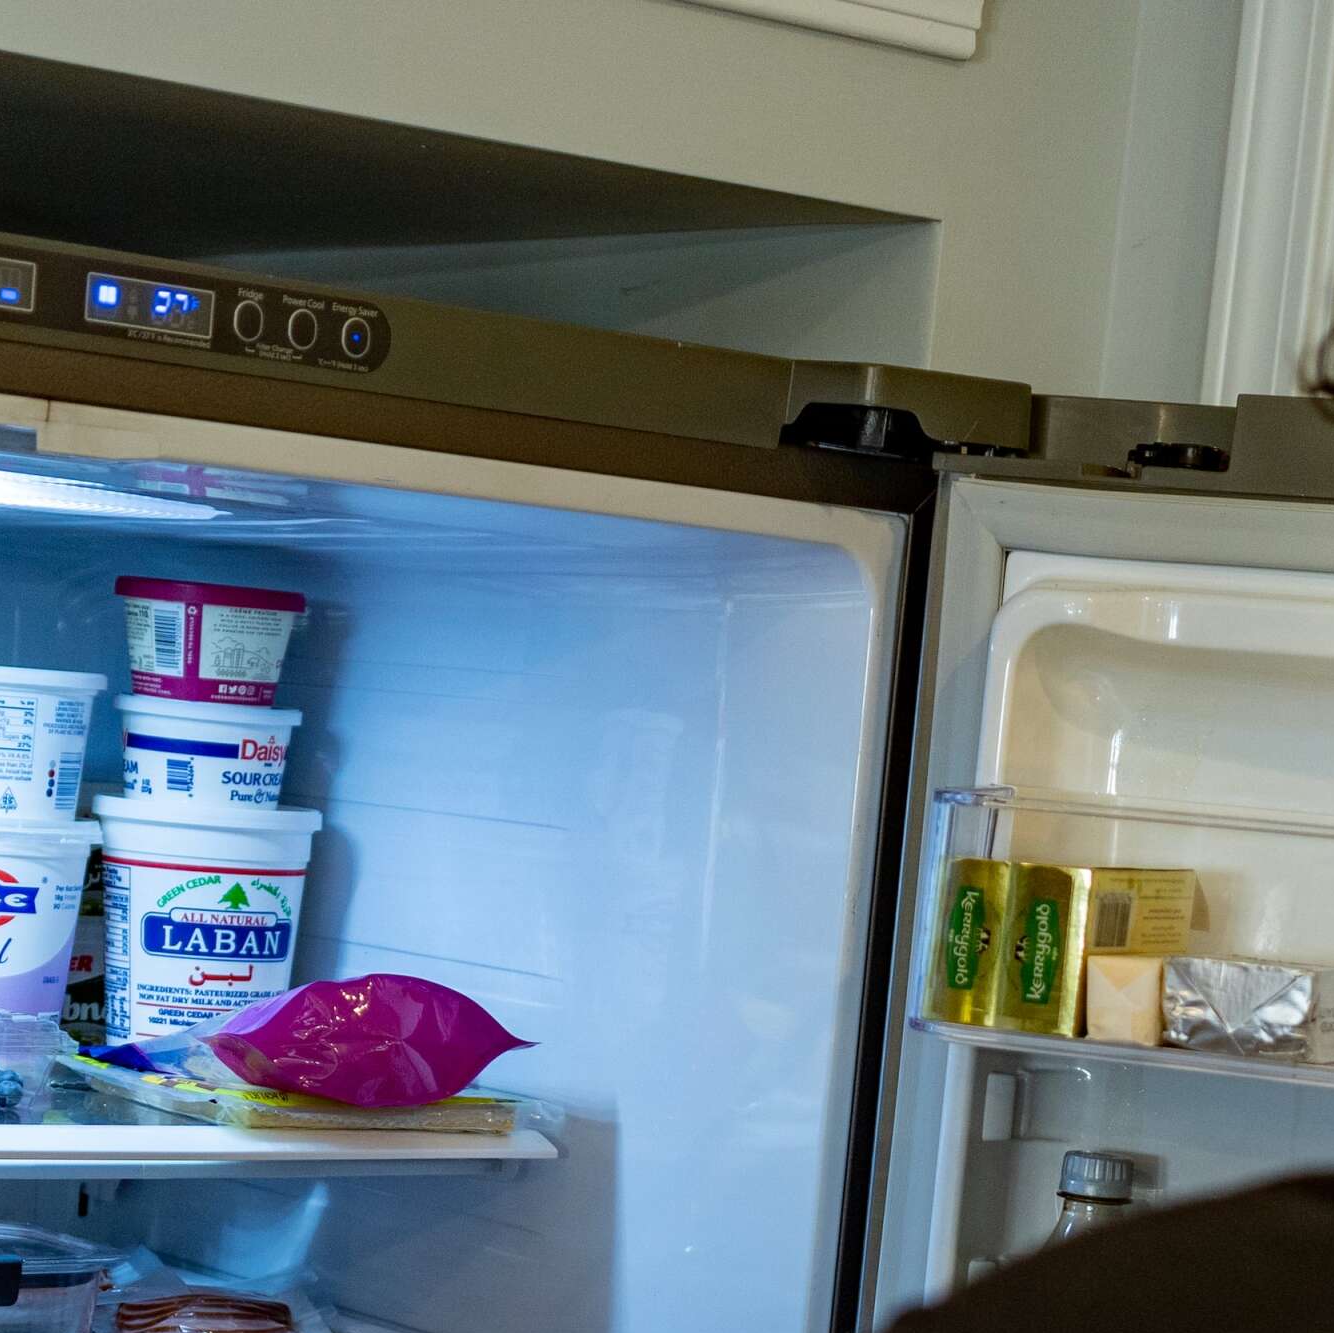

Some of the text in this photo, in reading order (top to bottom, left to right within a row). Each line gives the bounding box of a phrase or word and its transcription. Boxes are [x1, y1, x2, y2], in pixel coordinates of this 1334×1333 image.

[238, 287, 264, 300] Fridge
[282, 294, 325, 310] Power Cool
[332, 302, 379, 317] Energy Saver
[221, 770, 261, 786] SOUR
[230, 790, 253, 801] Pure
[156, 875, 222, 908] GREEN CEDAR
[181, 912, 268, 926] ALL NATURAL
[161, 925, 281, 956] LABAN
[188, 964, 254, 987] لبن
[137, 983, 193, 996] INGREDIENTS:
[194, 988, 248, 999] PASTEURIZED
[172, 996, 189, 1004] DRY
[191, 998, 215, 1006] MILK
[148, 1016, 168, 1025] 10221
[159, 1008, 213, 1018] GREEN CEDAR
